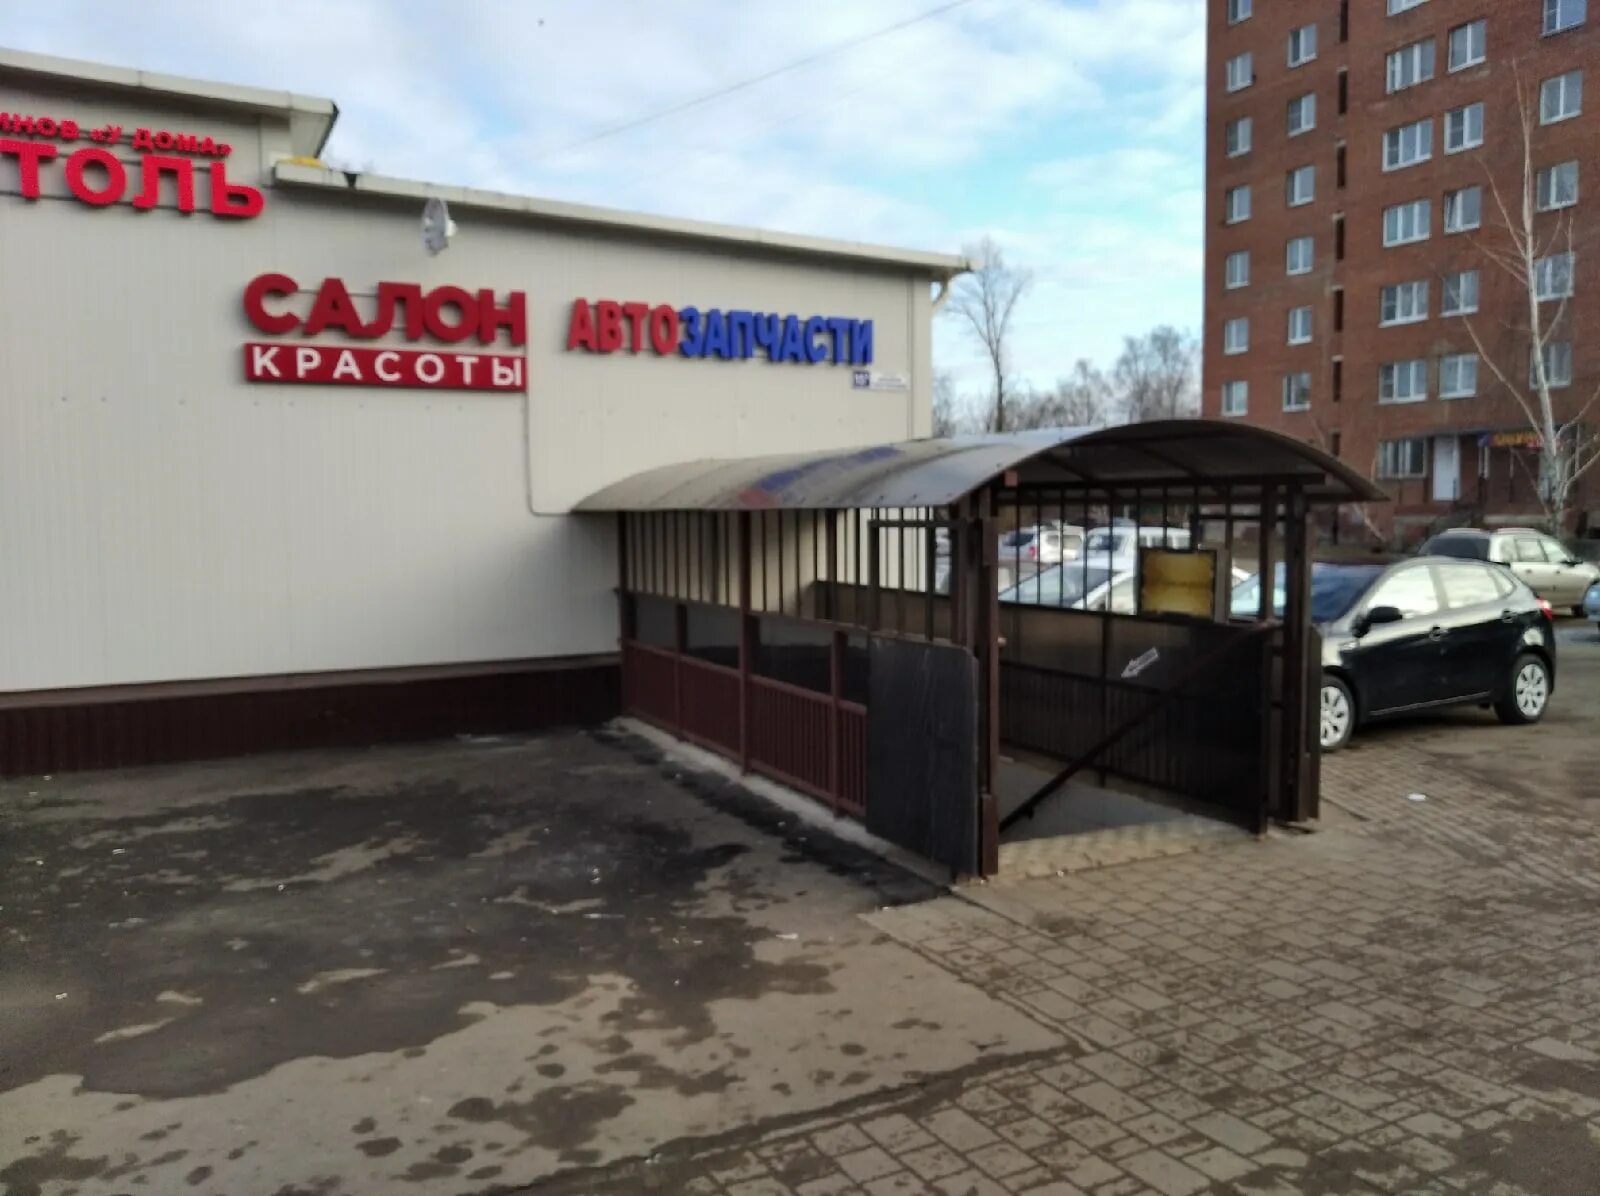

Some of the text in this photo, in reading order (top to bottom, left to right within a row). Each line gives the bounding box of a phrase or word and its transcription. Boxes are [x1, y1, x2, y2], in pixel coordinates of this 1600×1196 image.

[0, 138, 265, 218] ТОЛЬ
[244, 273, 526, 345] САЛОН
[567, 297, 873, 366] АВТОЗАПЧАСТИ
[252, 346, 522, 387] КРАСОТЫ
